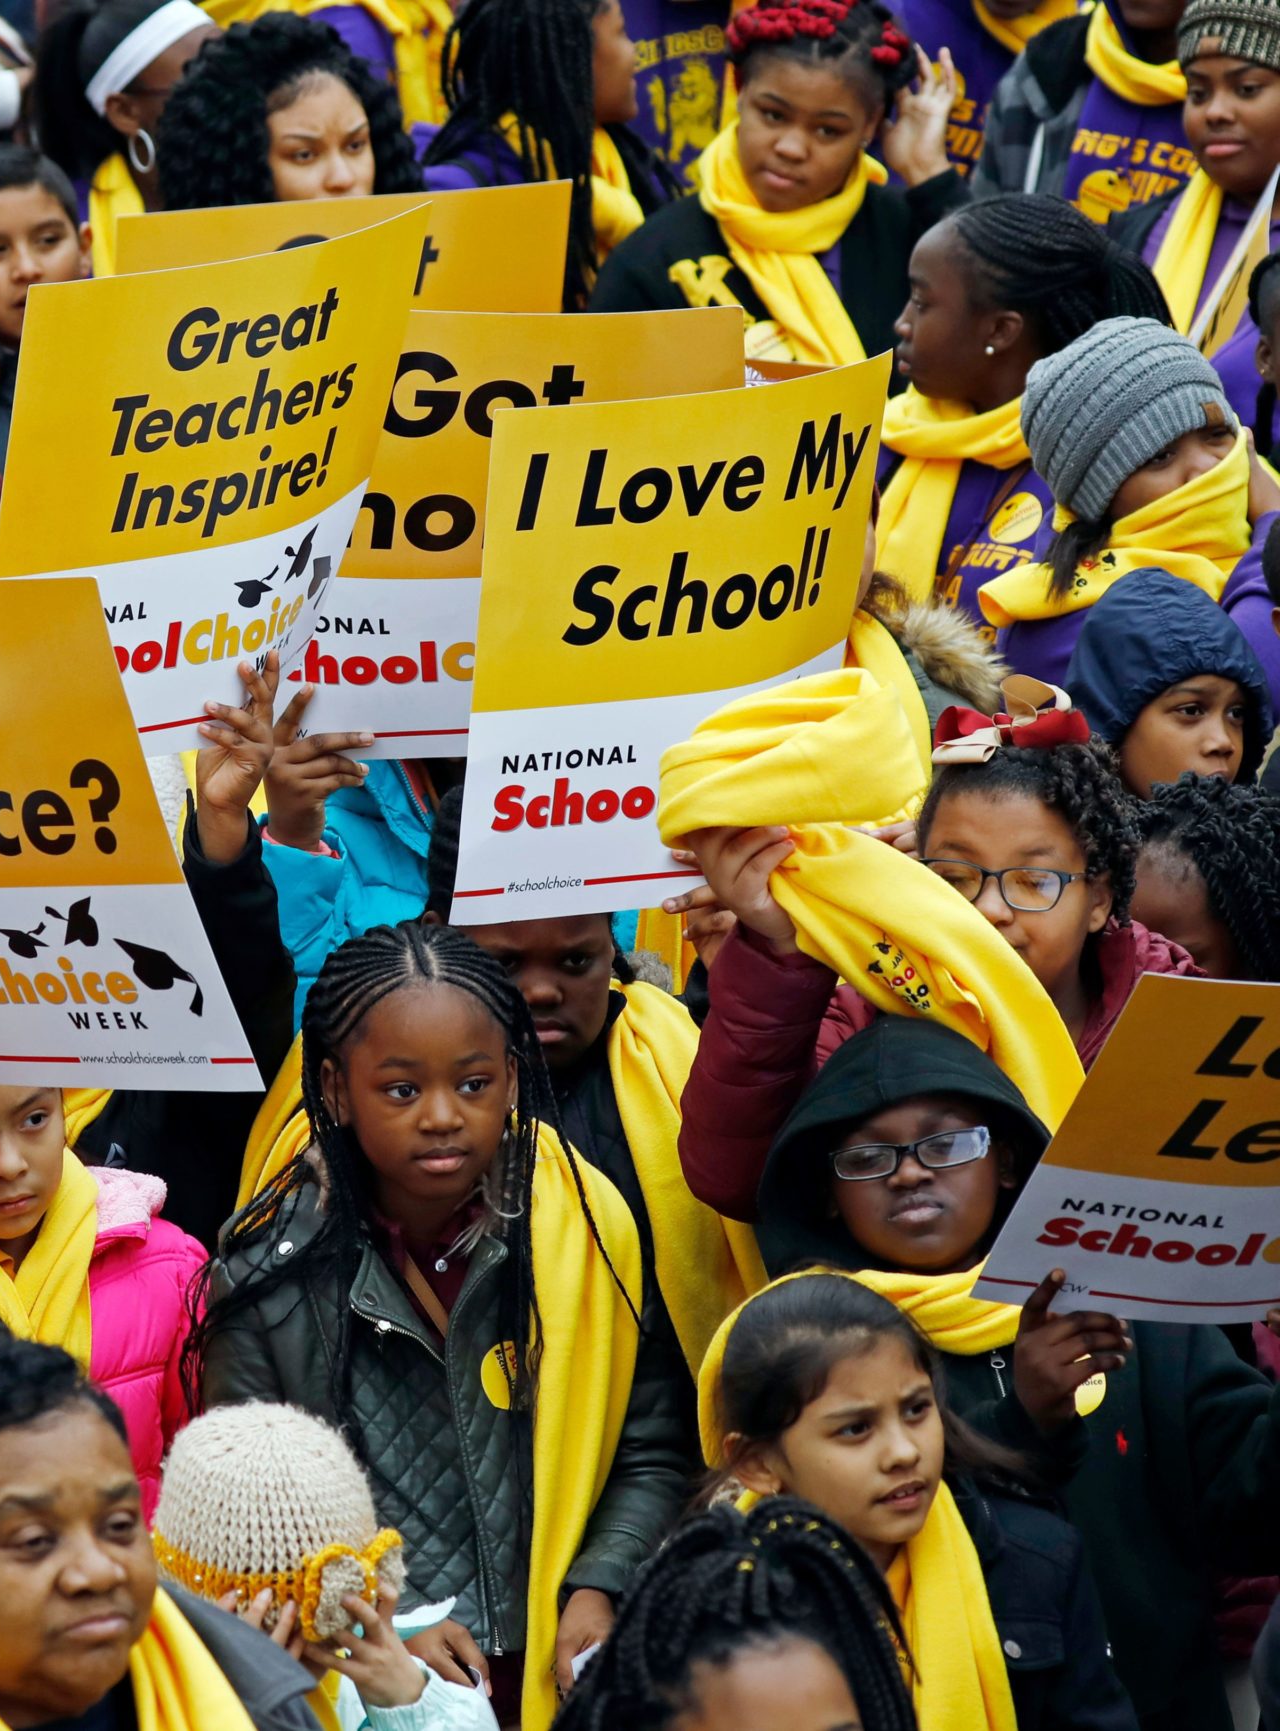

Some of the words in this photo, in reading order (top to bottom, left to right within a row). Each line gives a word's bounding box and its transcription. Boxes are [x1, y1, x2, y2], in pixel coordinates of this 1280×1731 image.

[167, 287, 339, 371] Great
[111, 363, 357, 457] Teachers
[383, 351, 585, 438] Got
[111, 426, 338, 538] Inspire!
[516, 453, 549, 531] I
[575, 449, 765, 527] Love
[784, 413, 872, 510] My
[561, 525, 831, 646] School!
[501, 745, 637, 774] NATIONAL
[491, 777, 656, 832] Schoo
[507, 876, 582, 894] #schoolchoice
[68, 1012, 149, 1030] WEEK
[81, 1052, 209, 1065] www.schoolchoiceweek.com
[1157, 1099, 1280, 1164] Le
[1035, 1217, 1280, 1266] School
[1061, 1198, 1225, 1228] NATIONAL
